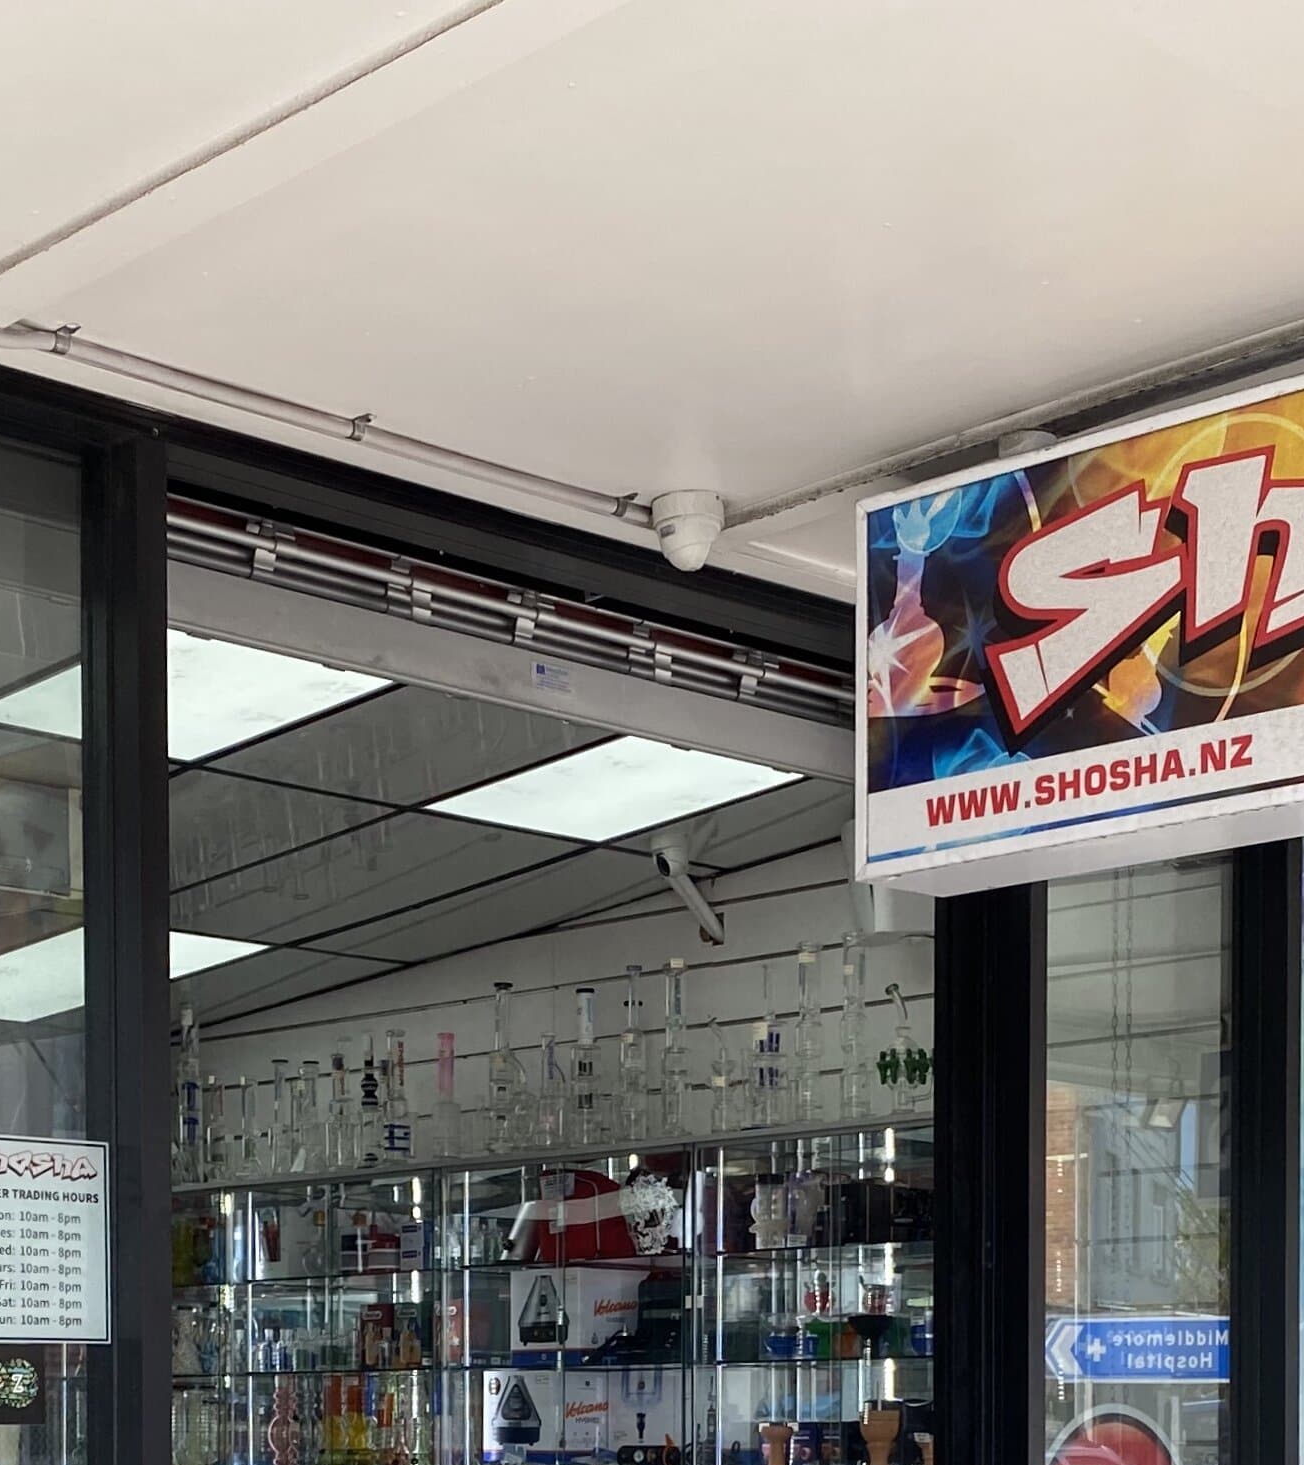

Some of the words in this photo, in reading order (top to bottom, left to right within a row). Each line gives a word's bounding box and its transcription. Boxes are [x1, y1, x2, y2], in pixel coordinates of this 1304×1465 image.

[925, 733, 1254, 828] WWW.SHOSHA.NZ
[12, 1188, 60, 1202] TRADING
[62, 1191, 99, 1204] HOURS
[19, 1210, 49, 1223] 10am
[57, 1213, 82, 1226] 8pm
[20, 1228, 49, 1241] 10am
[58, 1229, 82, 1242] 8pm
[20, 1245, 50, 1258] 10am
[58, 1247, 82, 1260] 8pm
[20, 1262, 50, 1275] 10am
[58, 1264, 82, 1277] 8pm
[20, 1280, 50, 1292] 10am
[58, 1281, 82, 1294] 8pm
[21, 1297, 50, 1310] 10am
[59, 1298, 83, 1311] 8pm
[21, 1314, 50, 1327] 10am
[59, 1315, 83, 1328] 8pm
